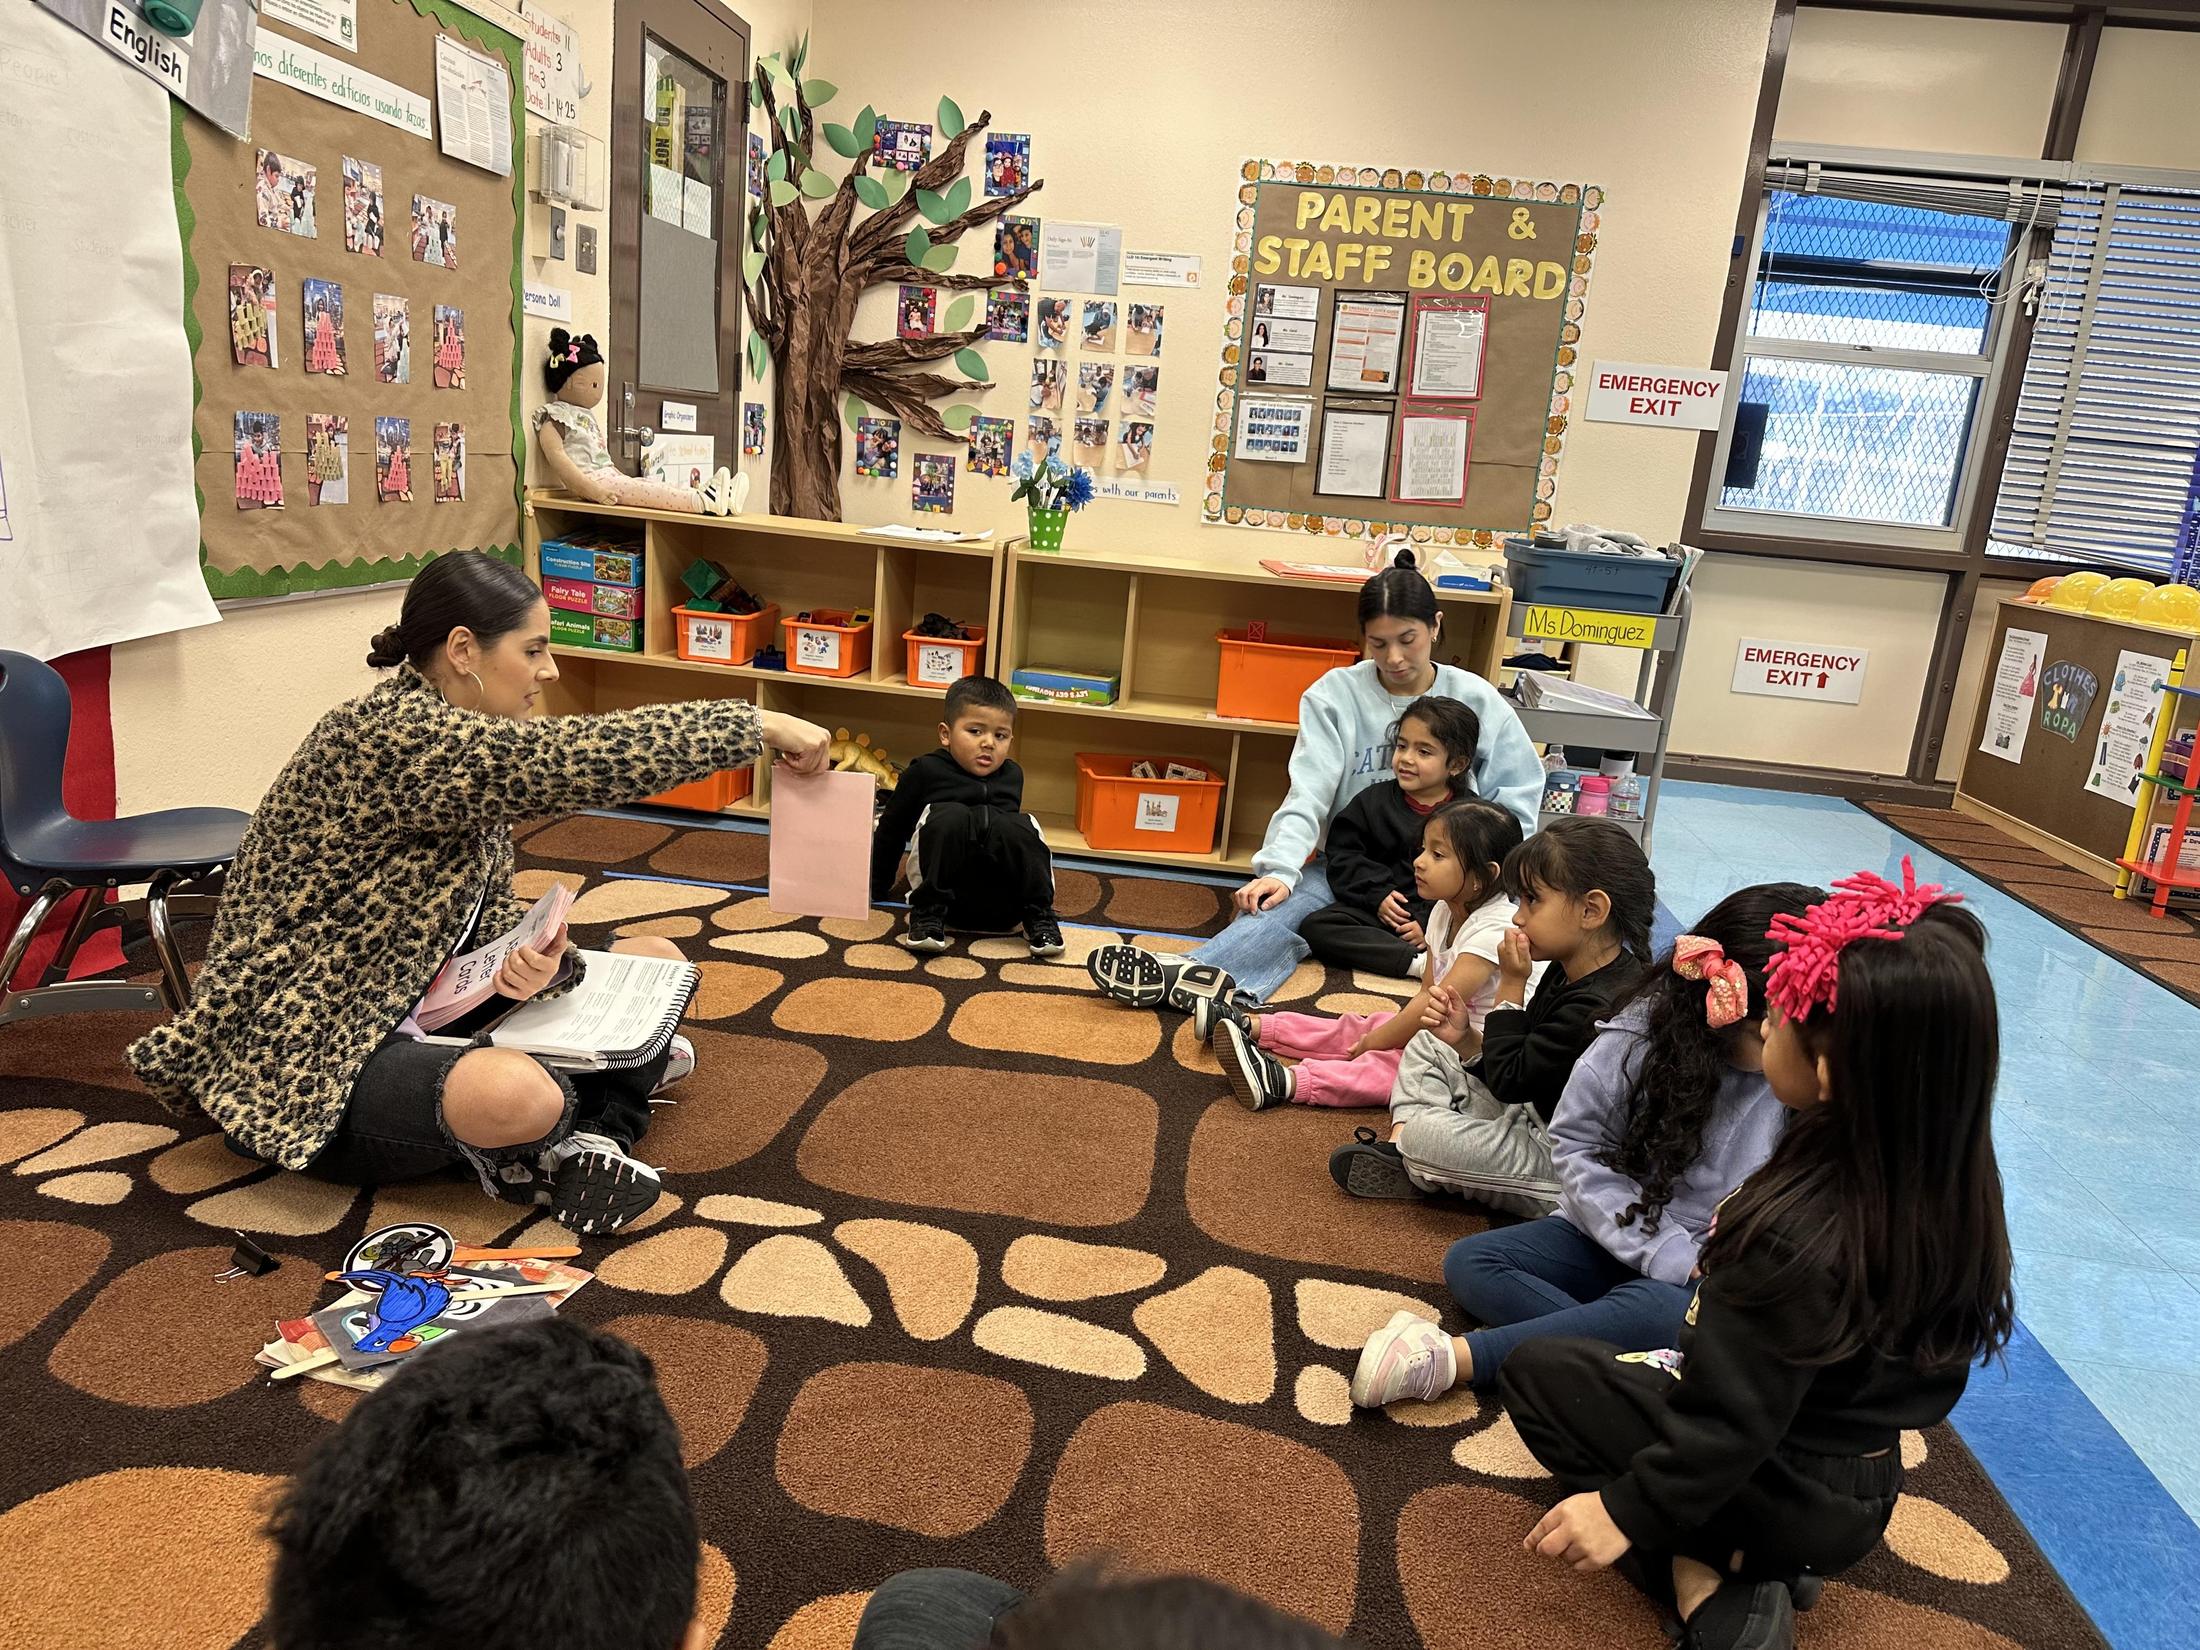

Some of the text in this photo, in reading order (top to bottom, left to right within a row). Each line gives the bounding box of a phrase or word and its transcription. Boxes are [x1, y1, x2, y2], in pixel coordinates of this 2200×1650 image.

[111, 6, 182, 84] English
[556, 52, 563, 72] 3
[278, 50, 327, 90] diferentes
[331, 74, 371, 107] edificios
[375, 98, 403, 120] usando
[1296, 192, 1537, 242] PARENT &
[1253, 235, 1567, 300] STAFF BOARD
[549, 293, 560, 307] Doll
[1599, 373, 1720, 397] EMERGENCY
[1630, 397, 1682, 416] EXIT
[1102, 483, 1121, 496] with
[1125, 489, 1138, 497] our
[1144, 487, 1176, 500] parents
[545, 556, 580, 567] Construction
[549, 593, 588, 605] FLOOR PUZZLE
[551, 585, 586, 599] Fairy Tale
[551, 619, 590, 631] afari Animals
[1529, 607, 1645, 645] Ms Dominguez
[1744, 647, 1860, 671] EMERGENCY
[1766, 669, 1812, 687] EXIT
[2043, 664, 2096, 698] CLOTHES
[1055, 690, 1069, 698] GET
[2043, 710, 2077, 739] ROPA
[480, 946, 501, 982] Letter
[454, 960, 477, 995] Cards
